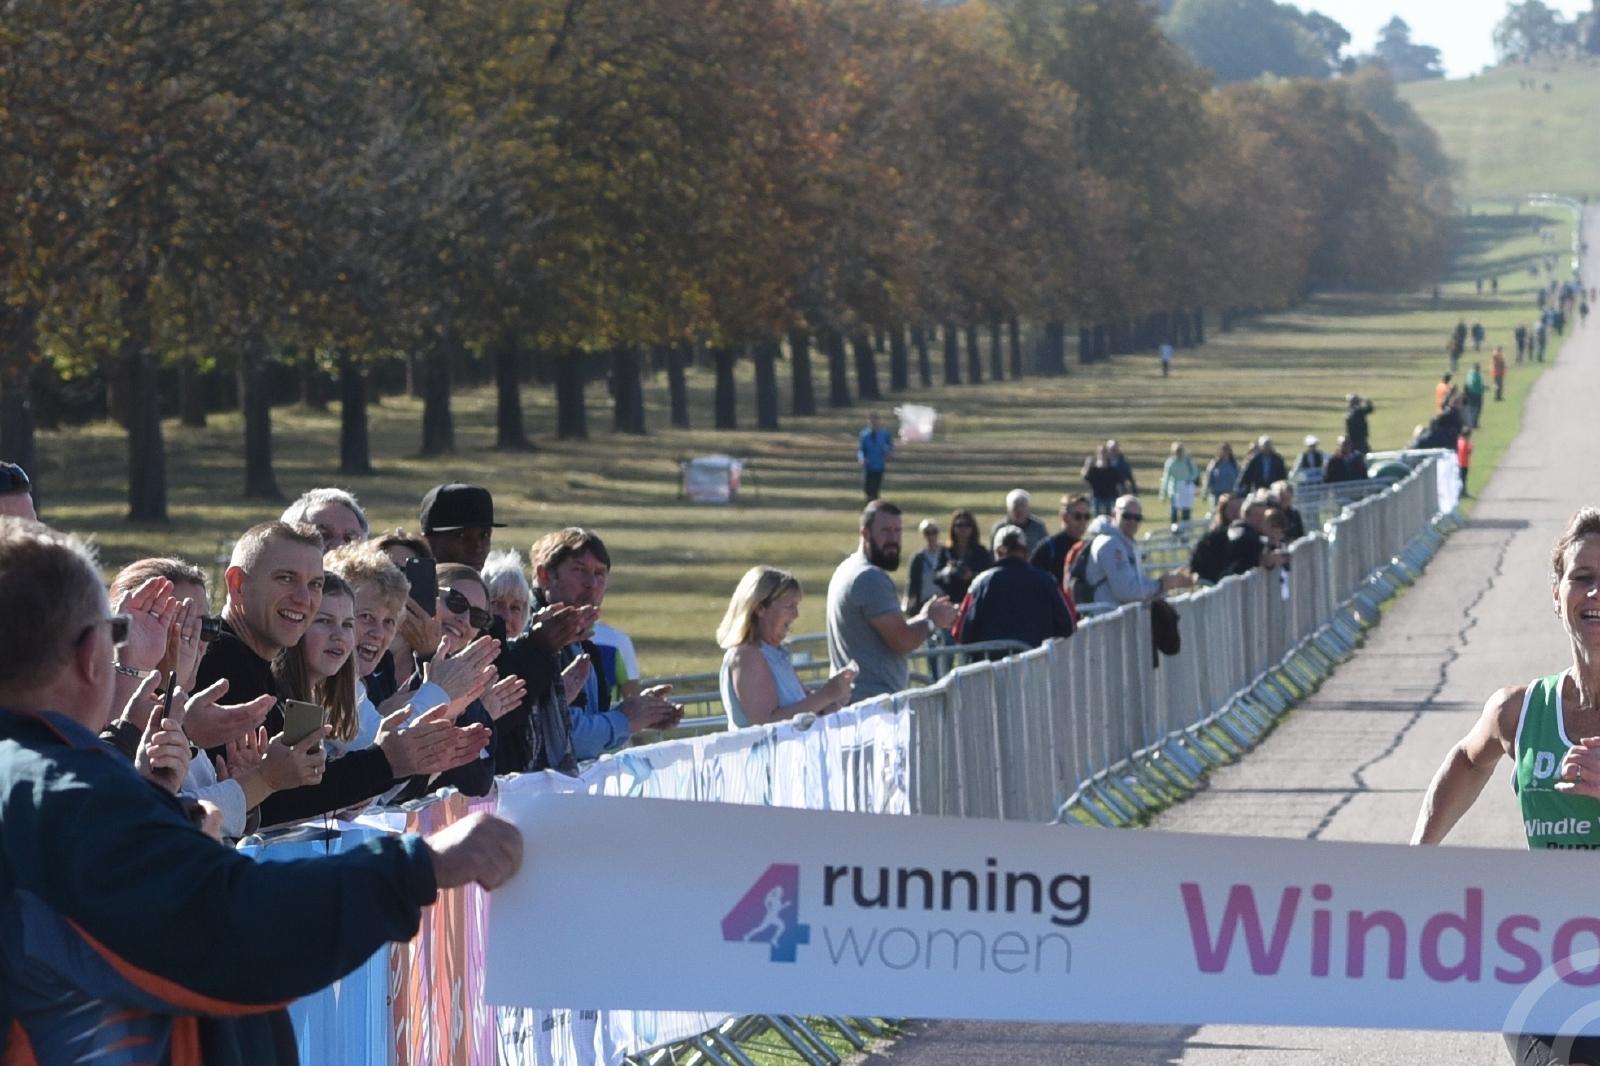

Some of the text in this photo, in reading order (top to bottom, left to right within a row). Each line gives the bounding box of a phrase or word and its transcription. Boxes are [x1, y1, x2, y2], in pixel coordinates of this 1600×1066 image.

[1524, 817, 1591, 837] Windle
[822, 857, 1091, 927] running
[822, 923, 1073, 974] women
